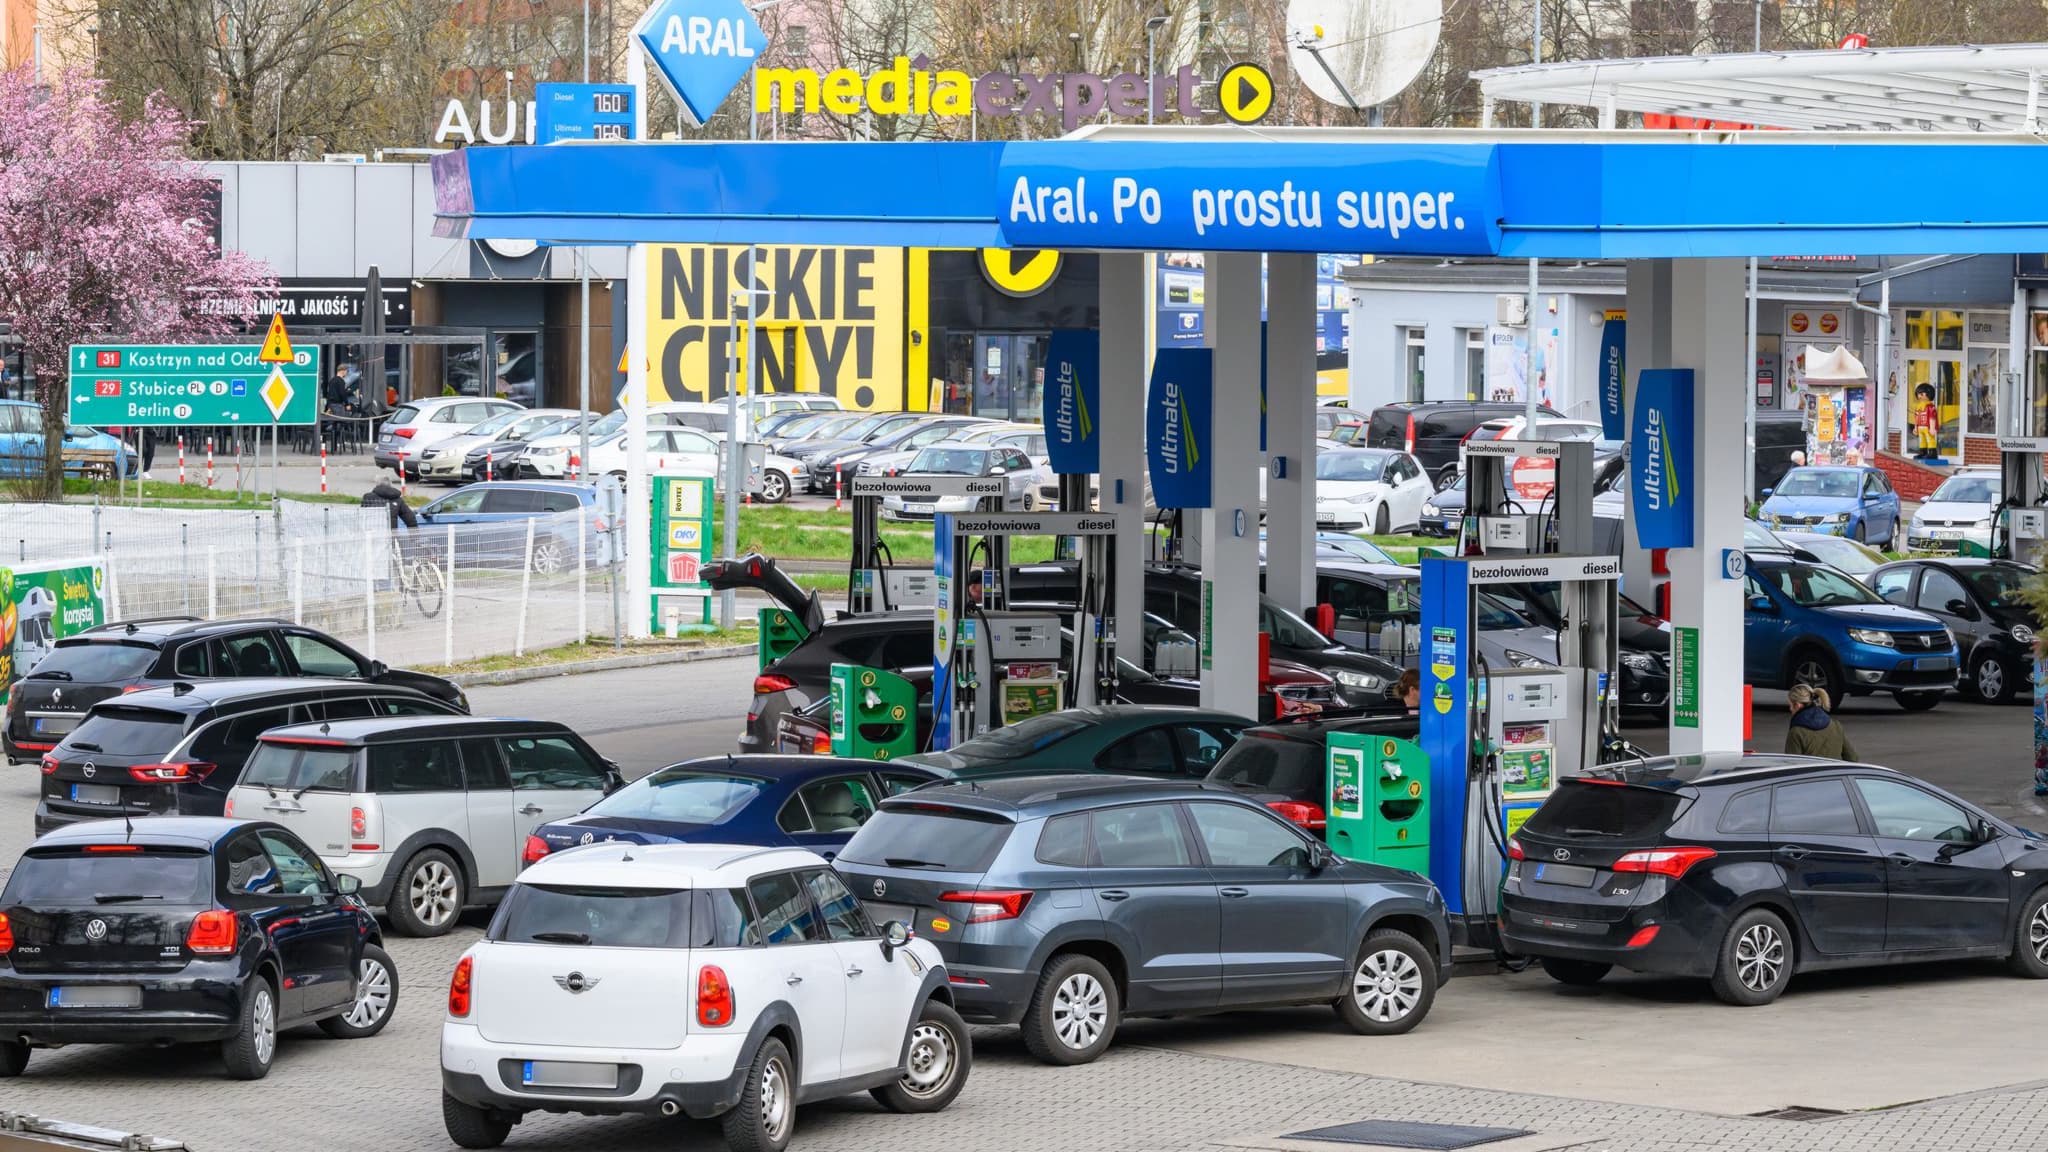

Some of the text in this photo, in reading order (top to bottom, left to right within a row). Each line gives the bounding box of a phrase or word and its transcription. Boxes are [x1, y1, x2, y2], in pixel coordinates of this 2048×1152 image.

[661, 15, 755, 58] ARAL
[555, 93, 574, 101] Diesel
[756, 53, 1203, 129] mediaexpert
[555, 125, 582, 133] Ultimate
[1009, 175, 1465, 239] Aral. Po prostu super.
[661, 248, 875, 320] NISKIE
[200, 299, 296, 315] RZEMIELNICZA
[300, 296, 348, 315] JAKOŚĆ
[103, 353, 115, 364] 31
[129, 352, 191, 369] Kostrzyn
[197, 352, 225, 366] nad
[661, 325, 875, 408] CENY!
[101, 383, 115, 394] 29
[129, 382, 184, 396] Słubice
[190, 383, 202, 393] PL
[1604, 346, 1619, 415] ultimate
[128, 403, 171, 417] Berlin
[1057, 361, 1072, 443] ultimate
[1161, 383, 1178, 474] ultimate
[1467, 444, 1559, 455] bezołowiowa diesel
[1644, 408, 1660, 510] ultimate
[854, 481, 1001, 492] bezołowiowa diesel
[957, 519, 1115, 531] bezołowiowa diesel
[675, 530, 696, 539] DKV
[1472, 562, 1618, 579] bezołowiowa diesel
[1729, 558, 1742, 572] 12
[63, 602, 94, 627] korzystaj
